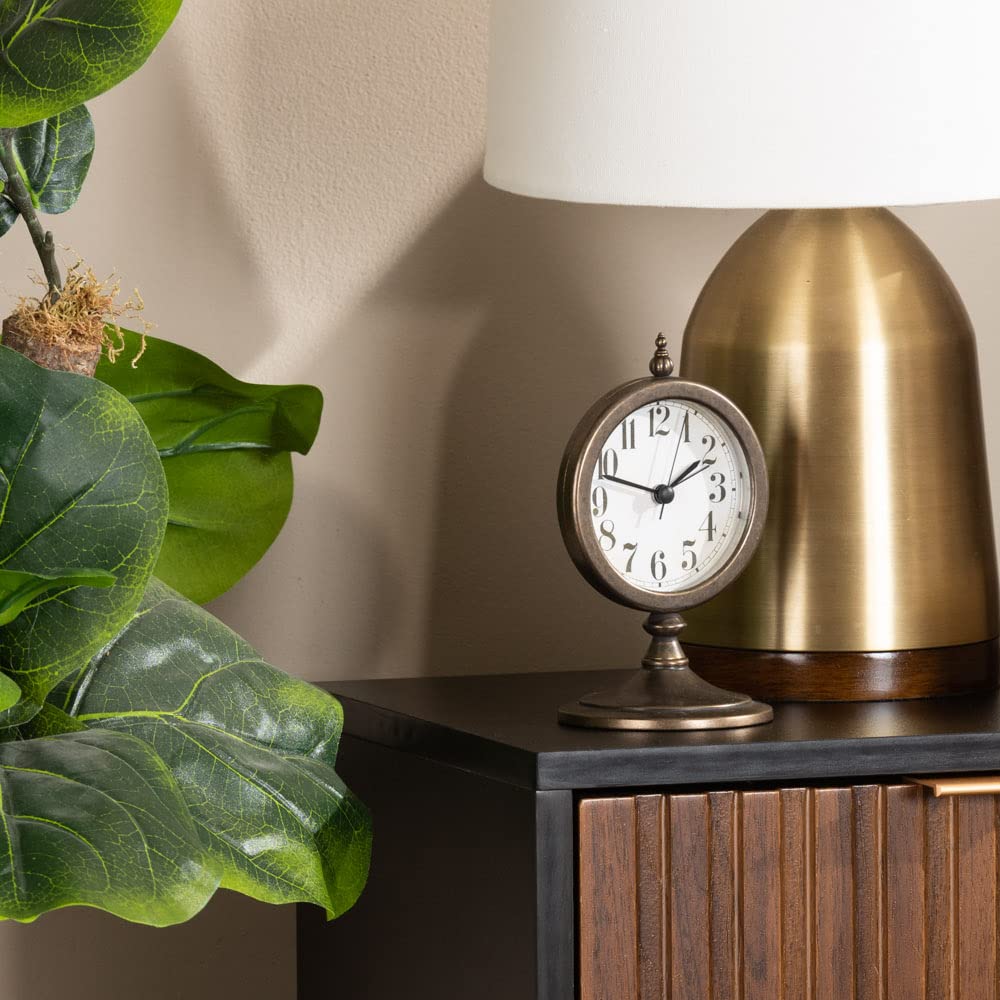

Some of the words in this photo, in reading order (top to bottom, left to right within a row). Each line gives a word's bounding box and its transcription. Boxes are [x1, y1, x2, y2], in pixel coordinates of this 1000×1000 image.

[621, 418, 636, 449] 11
[648, 405, 671, 437] 12
[684, 410, 691, 443] 1
[597, 448, 619, 480] 10
[702, 434, 717, 465] 2
[592, 486, 608, 517] 9
[709, 472, 726, 503] 3
[599, 519, 617, 551] 8
[698, 510, 717, 541] 4
[623, 542, 638, 573] 7
[650, 549, 667, 580] 6
[681, 539, 697, 570] 5
